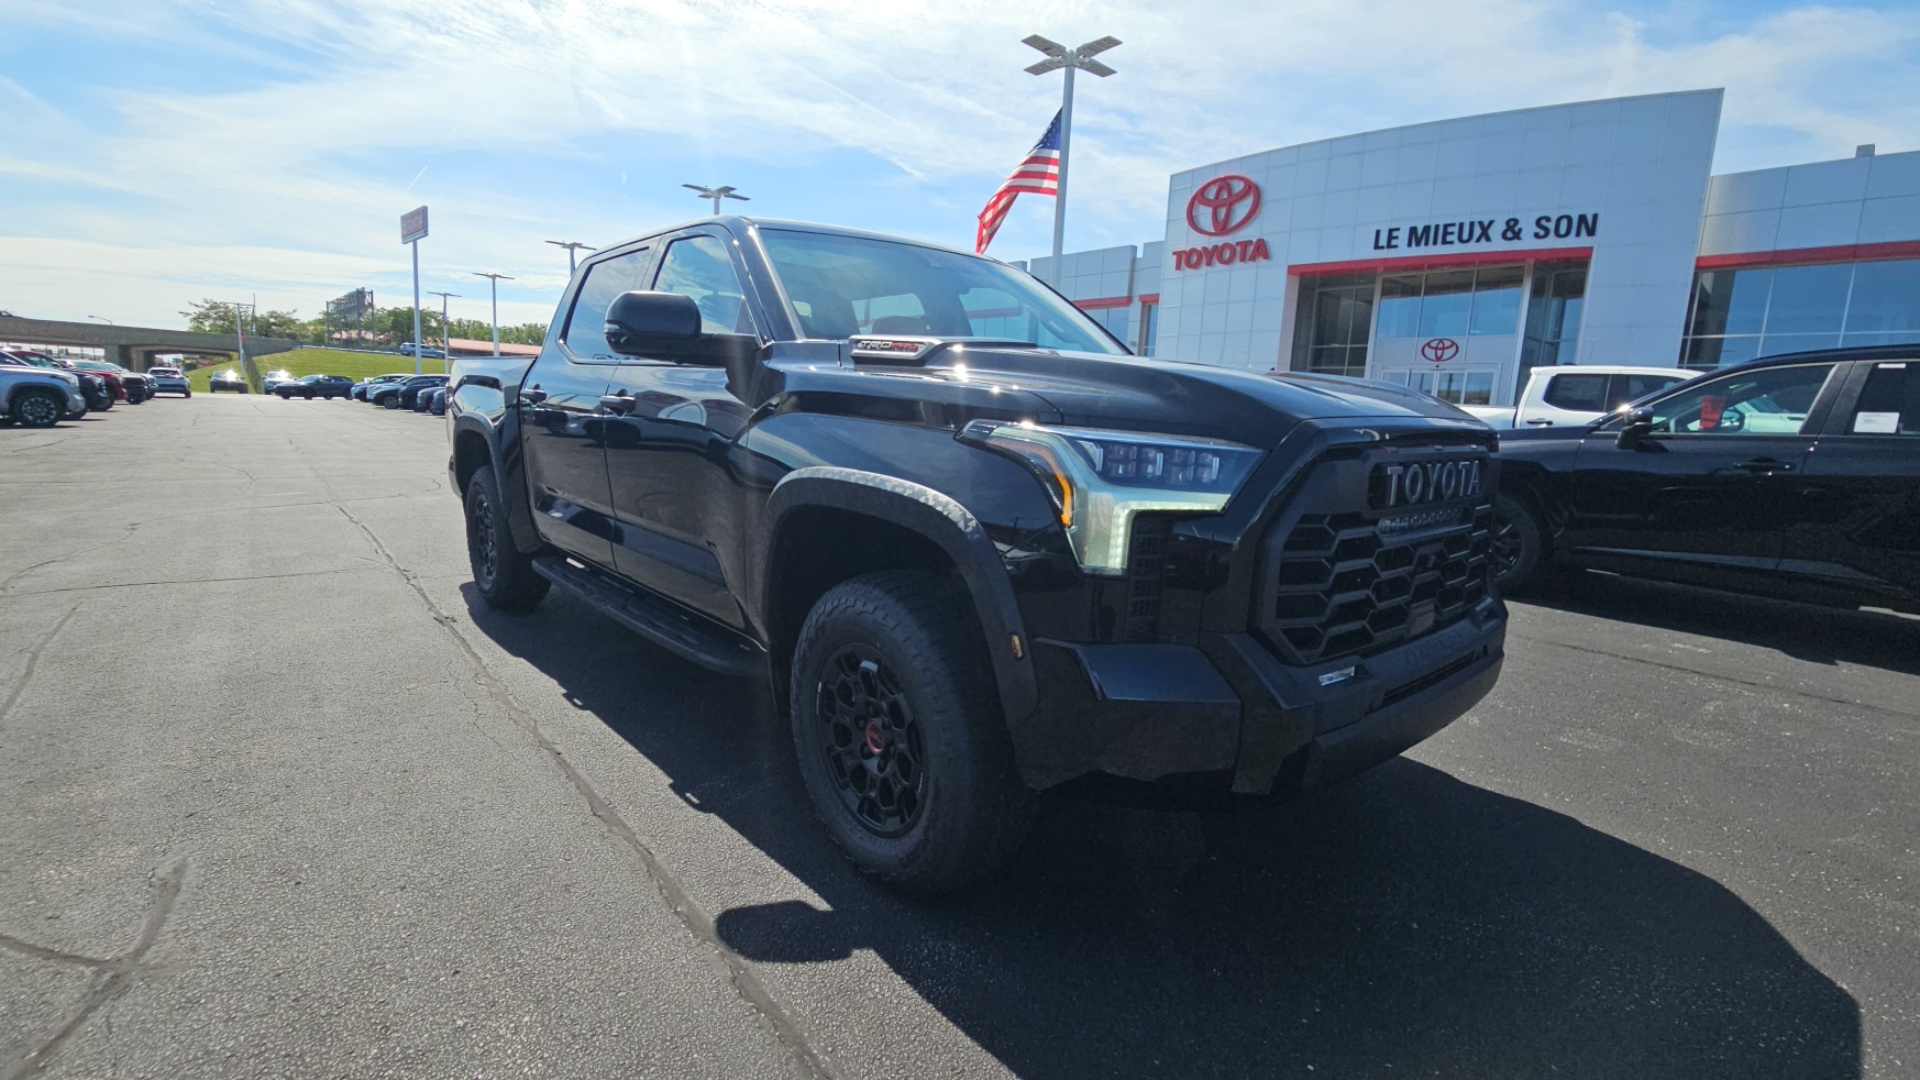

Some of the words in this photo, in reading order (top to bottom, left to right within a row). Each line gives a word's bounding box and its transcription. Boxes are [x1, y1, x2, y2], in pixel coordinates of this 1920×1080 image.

[1373, 228, 1400, 250] LE
[1407, 219, 1495, 247] MIEUX
[1501, 217, 1523, 241] &
[1533, 213, 1599, 239] SON
[1172, 238, 1270, 271] TOYOTA
[1387, 460, 1480, 507] TOYOTA
